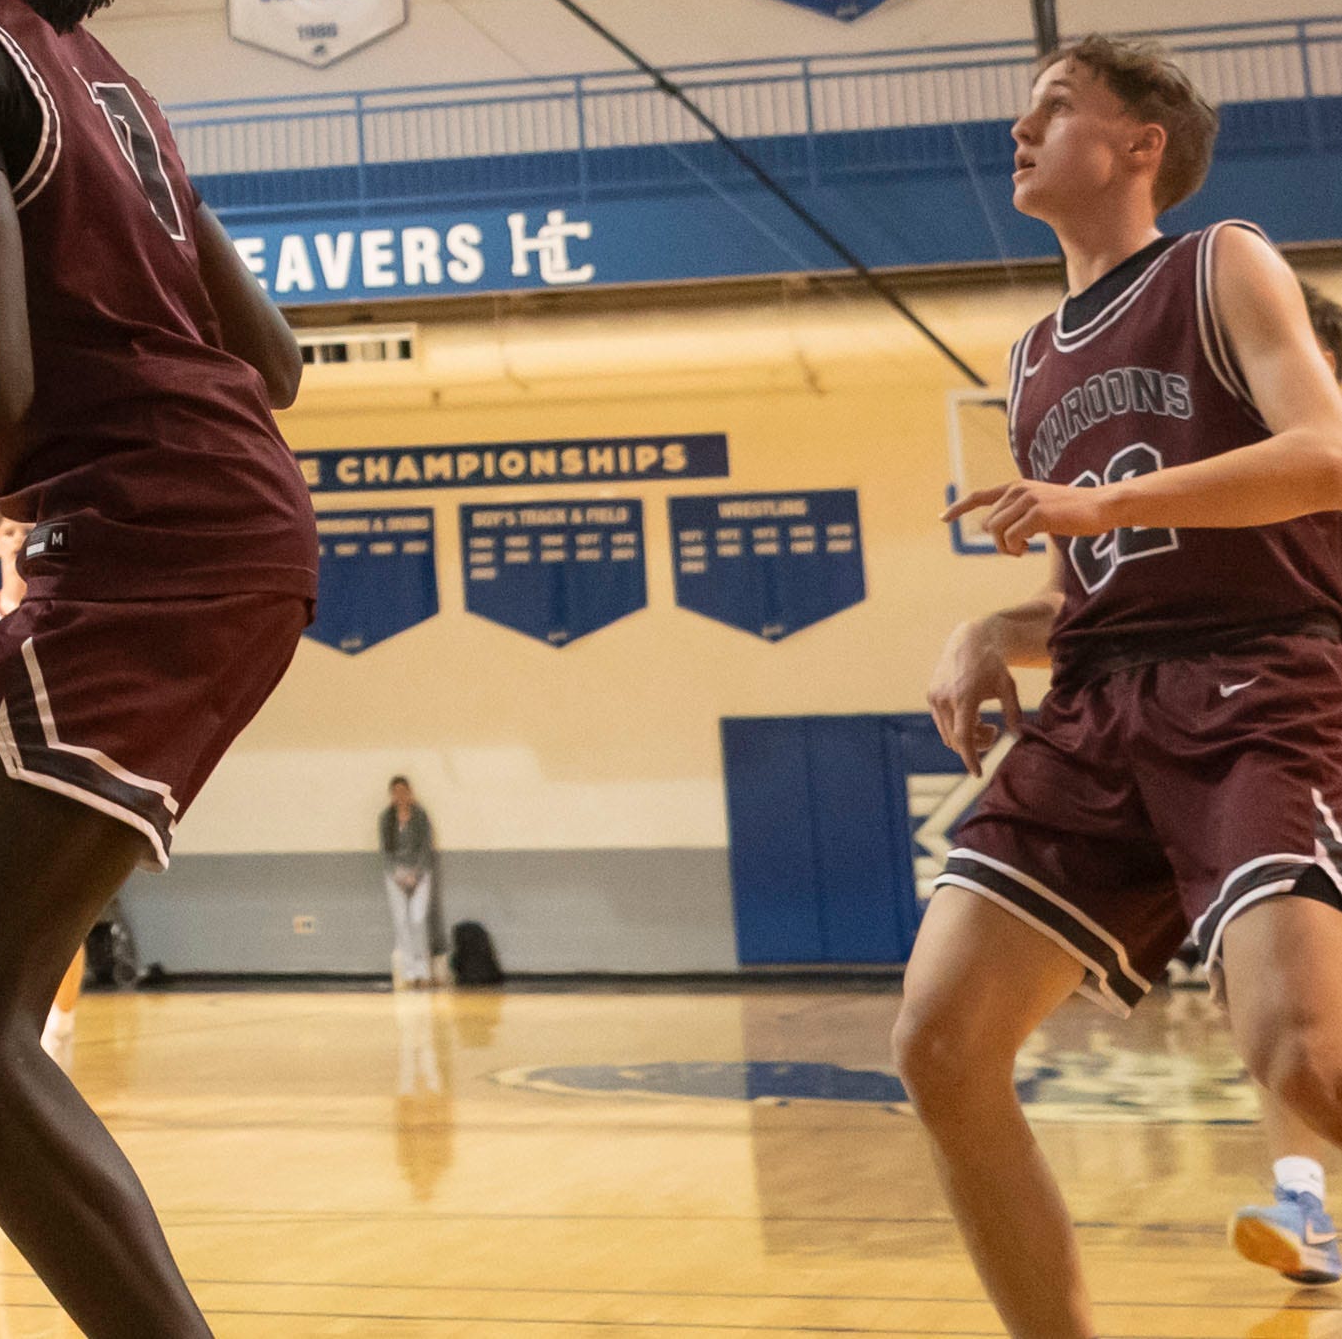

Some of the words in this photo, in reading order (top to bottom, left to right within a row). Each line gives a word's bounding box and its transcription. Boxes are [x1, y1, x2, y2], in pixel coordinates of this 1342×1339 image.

[233, 223, 485, 292] EAVERS
[1028, 367, 1193, 480] MAROONS
[335, 442, 688, 485] CHAMPIONSHIPS
[51, 532, 63, 546] M
